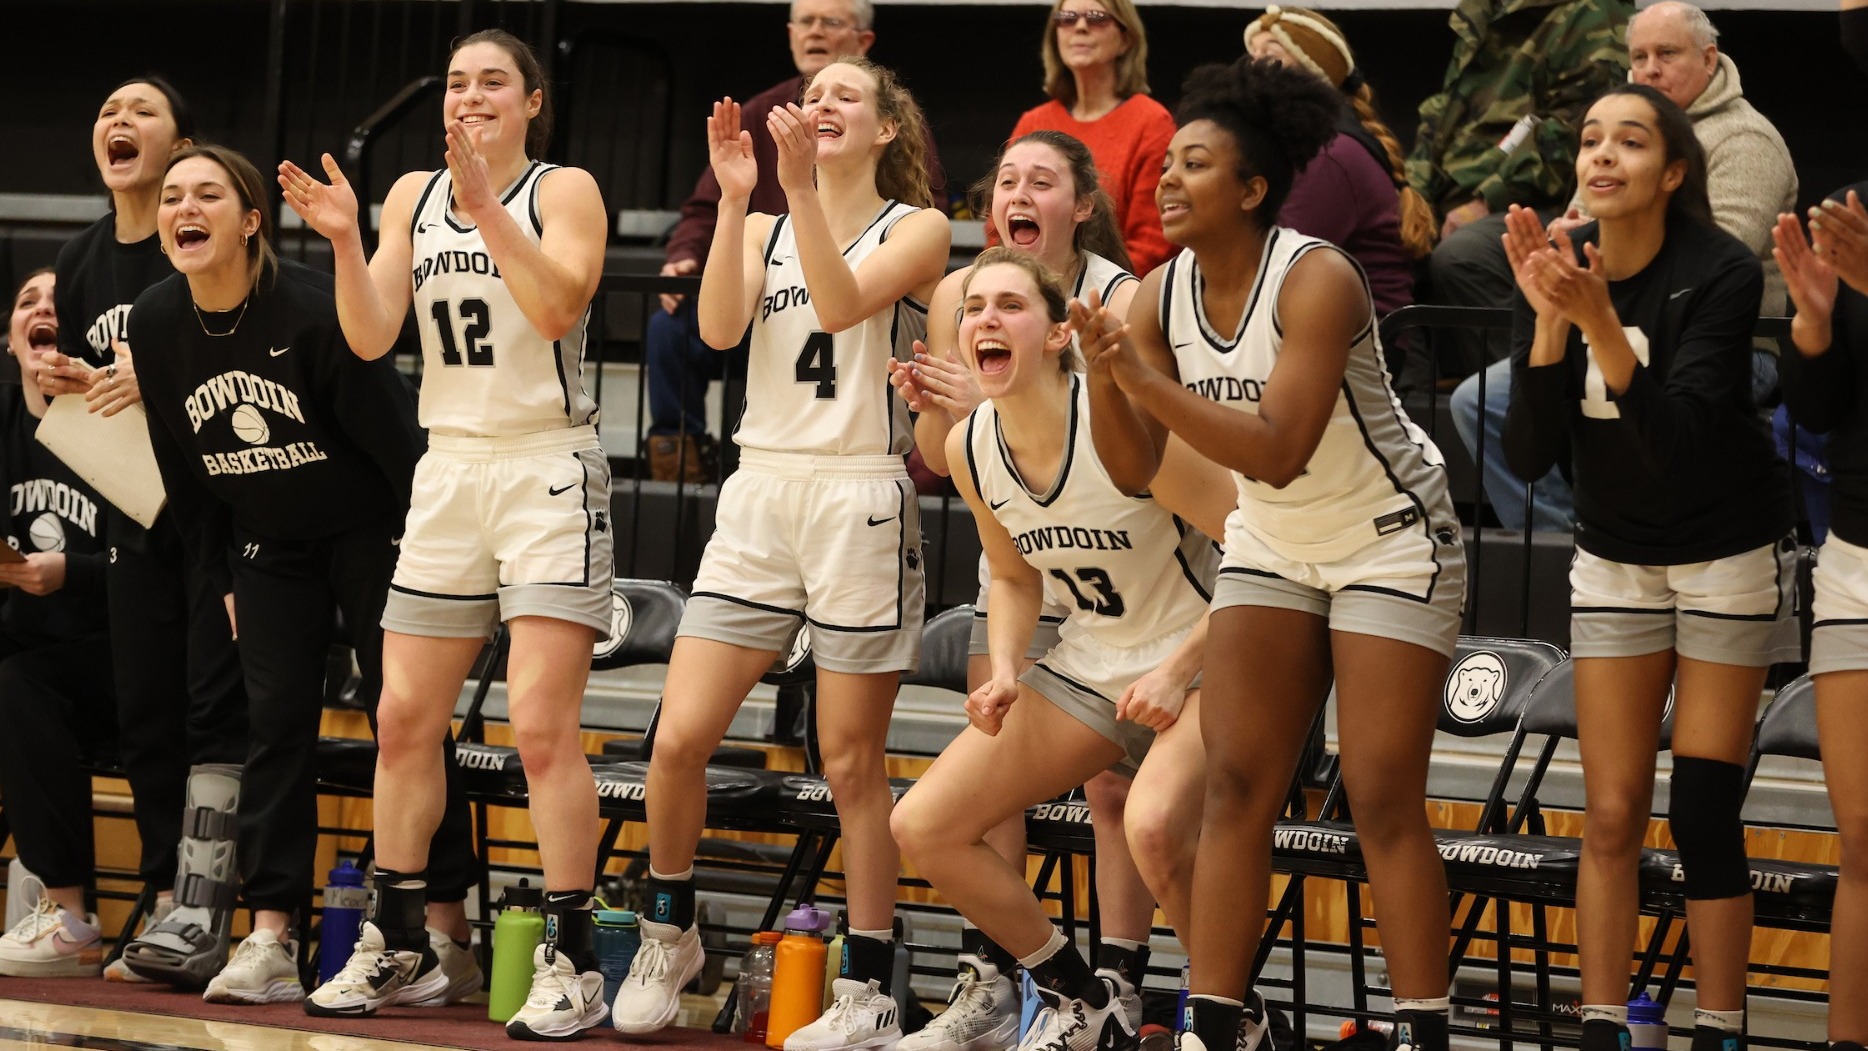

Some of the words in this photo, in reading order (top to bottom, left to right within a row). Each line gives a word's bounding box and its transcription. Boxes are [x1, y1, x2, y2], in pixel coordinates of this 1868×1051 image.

[430, 297, 496, 368] 12
[794, 329, 838, 401] 4
[184, 370, 306, 434] BOWDOIN
[202, 441, 328, 476] BASKETBALL
[109, 546, 118, 564] 3
[243, 542, 260, 559] 11
[1048, 566, 1127, 619] 13
[595, 781, 646, 801] OWD
[1552, 1003, 1582, 1015] MAX
